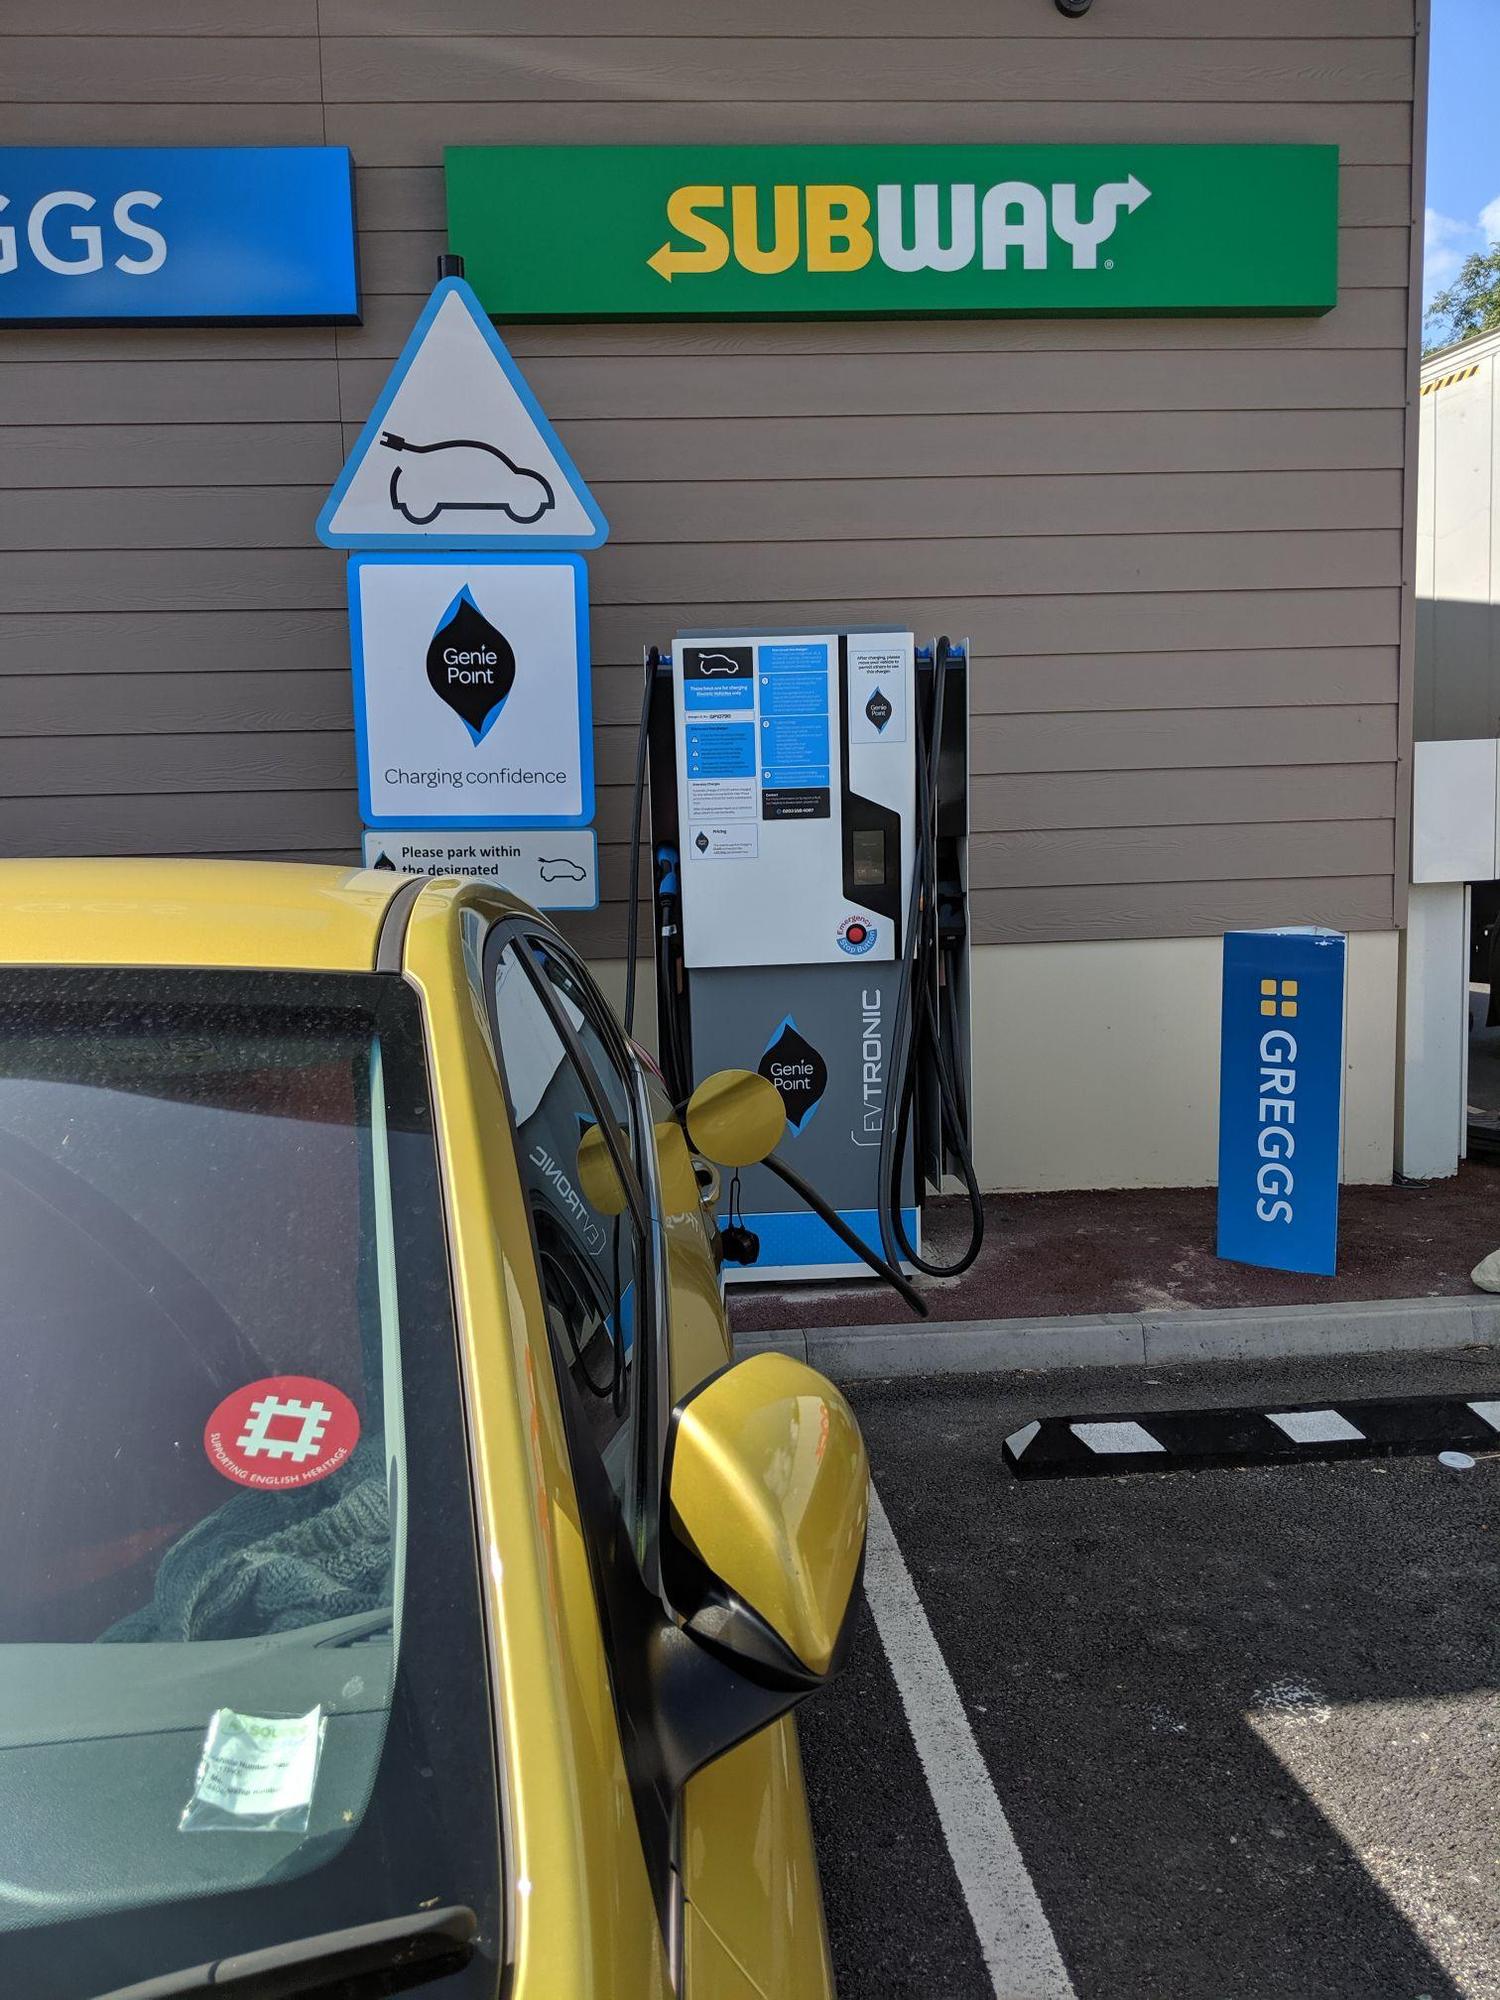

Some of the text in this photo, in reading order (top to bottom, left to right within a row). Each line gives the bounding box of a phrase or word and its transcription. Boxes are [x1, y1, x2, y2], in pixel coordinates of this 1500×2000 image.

[0, 190, 168, 276] GS
[646, 173, 1153, 283] SUBWAY
[443, 645, 498, 666] Genie
[447, 667, 494, 684] Point
[384, 768, 567, 788] Charging confidence
[402, 846, 521, 860] Please park within
[402, 864, 498, 876] the designated
[836, 915, 872, 935] Emergency
[840, 931, 874, 953] Stop Button
[770, 1059, 814, 1076] Genie
[862, 988, 882, 1132] EVTRONIC
[774, 1078, 811, 1090] Point
[1256, 1030, 1298, 1225] GREGGS
[211, 1432, 348, 1484] SUPPORTING ENGLISH HERITAGE
